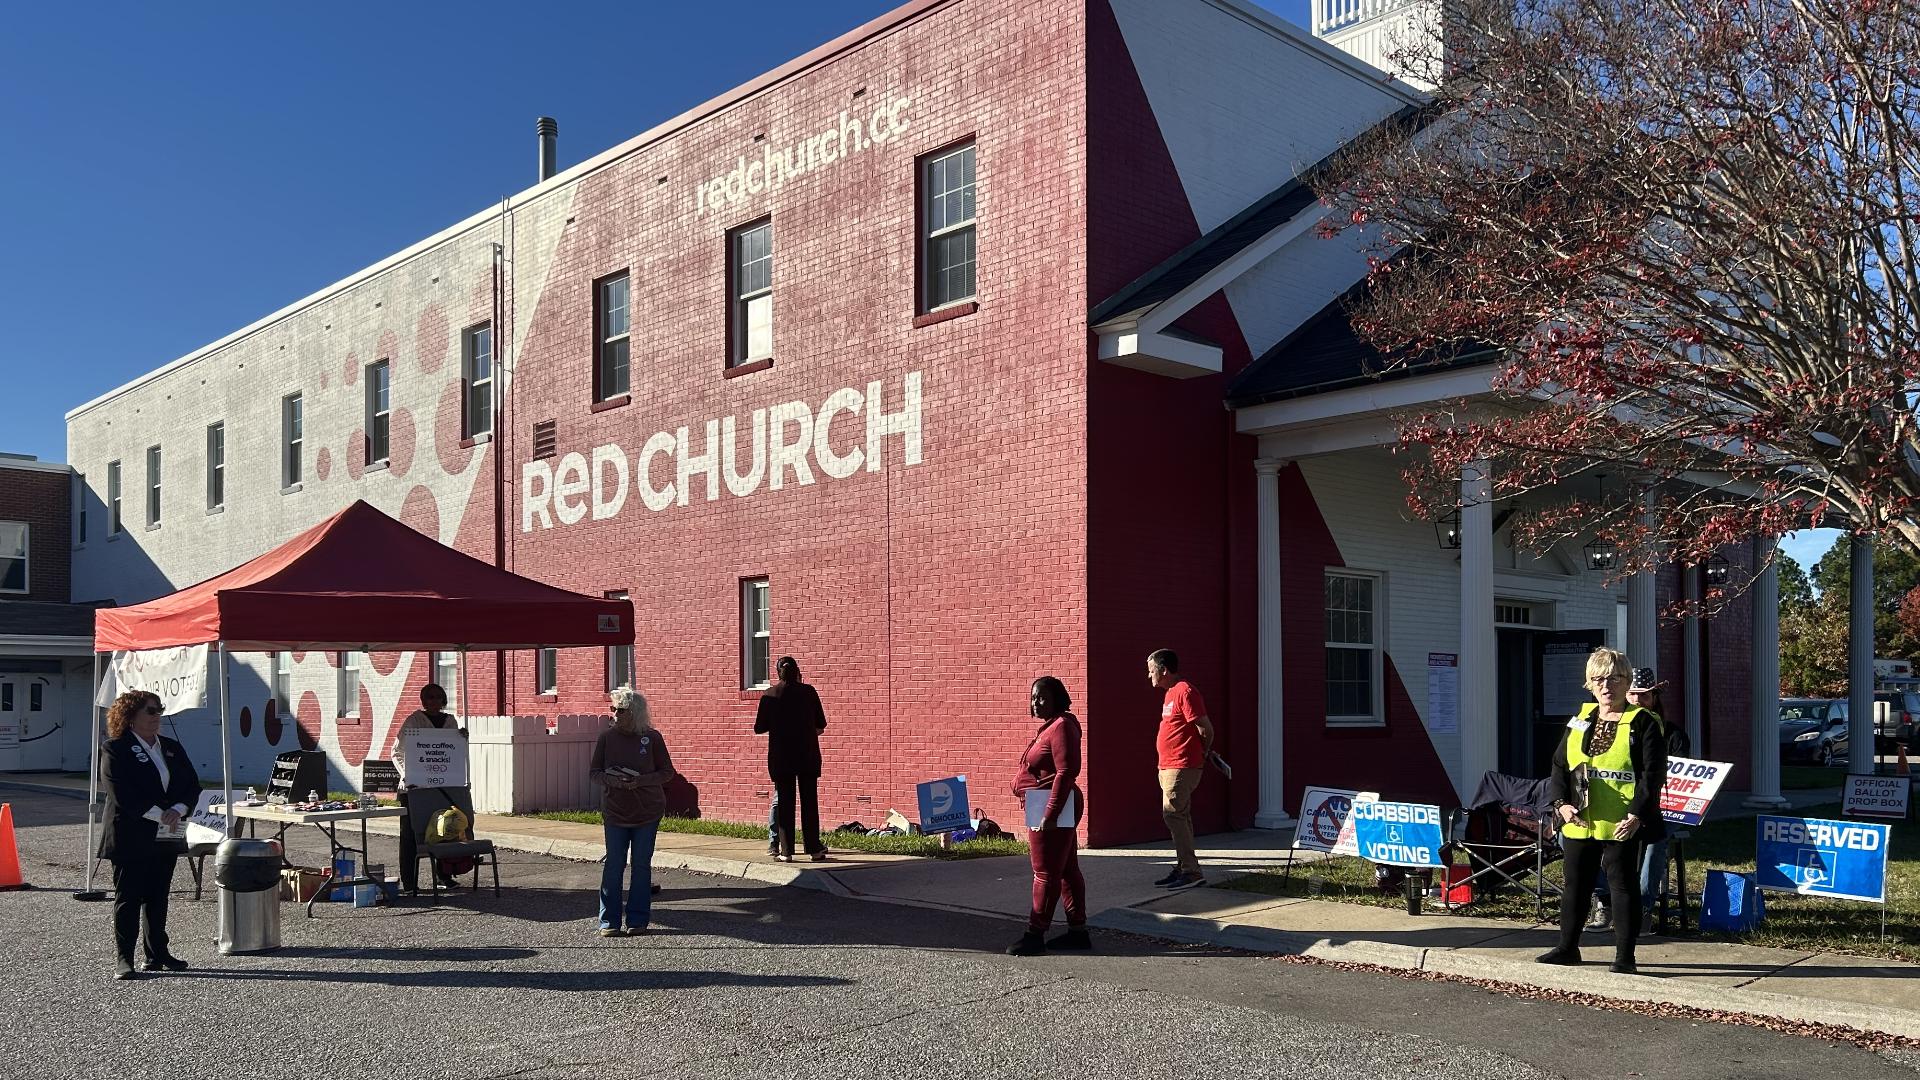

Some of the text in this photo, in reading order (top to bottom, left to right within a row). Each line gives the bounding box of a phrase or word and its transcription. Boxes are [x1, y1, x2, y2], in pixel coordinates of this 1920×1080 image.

[698, 96, 913, 216] redchurch.cc
[638, 370, 924, 513] CHURCH
[1684, 763, 1718, 780] FOR
[1854, 779, 1902, 788] OFFICIAL
[1855, 788, 1896, 797] BALLOT
[1848, 797, 1904, 807] DROP BOX
[1353, 802, 1439, 825] CURBSIDE
[1763, 820, 1880, 851] RESERVED
[1366, 842, 1431, 864] VOTING
